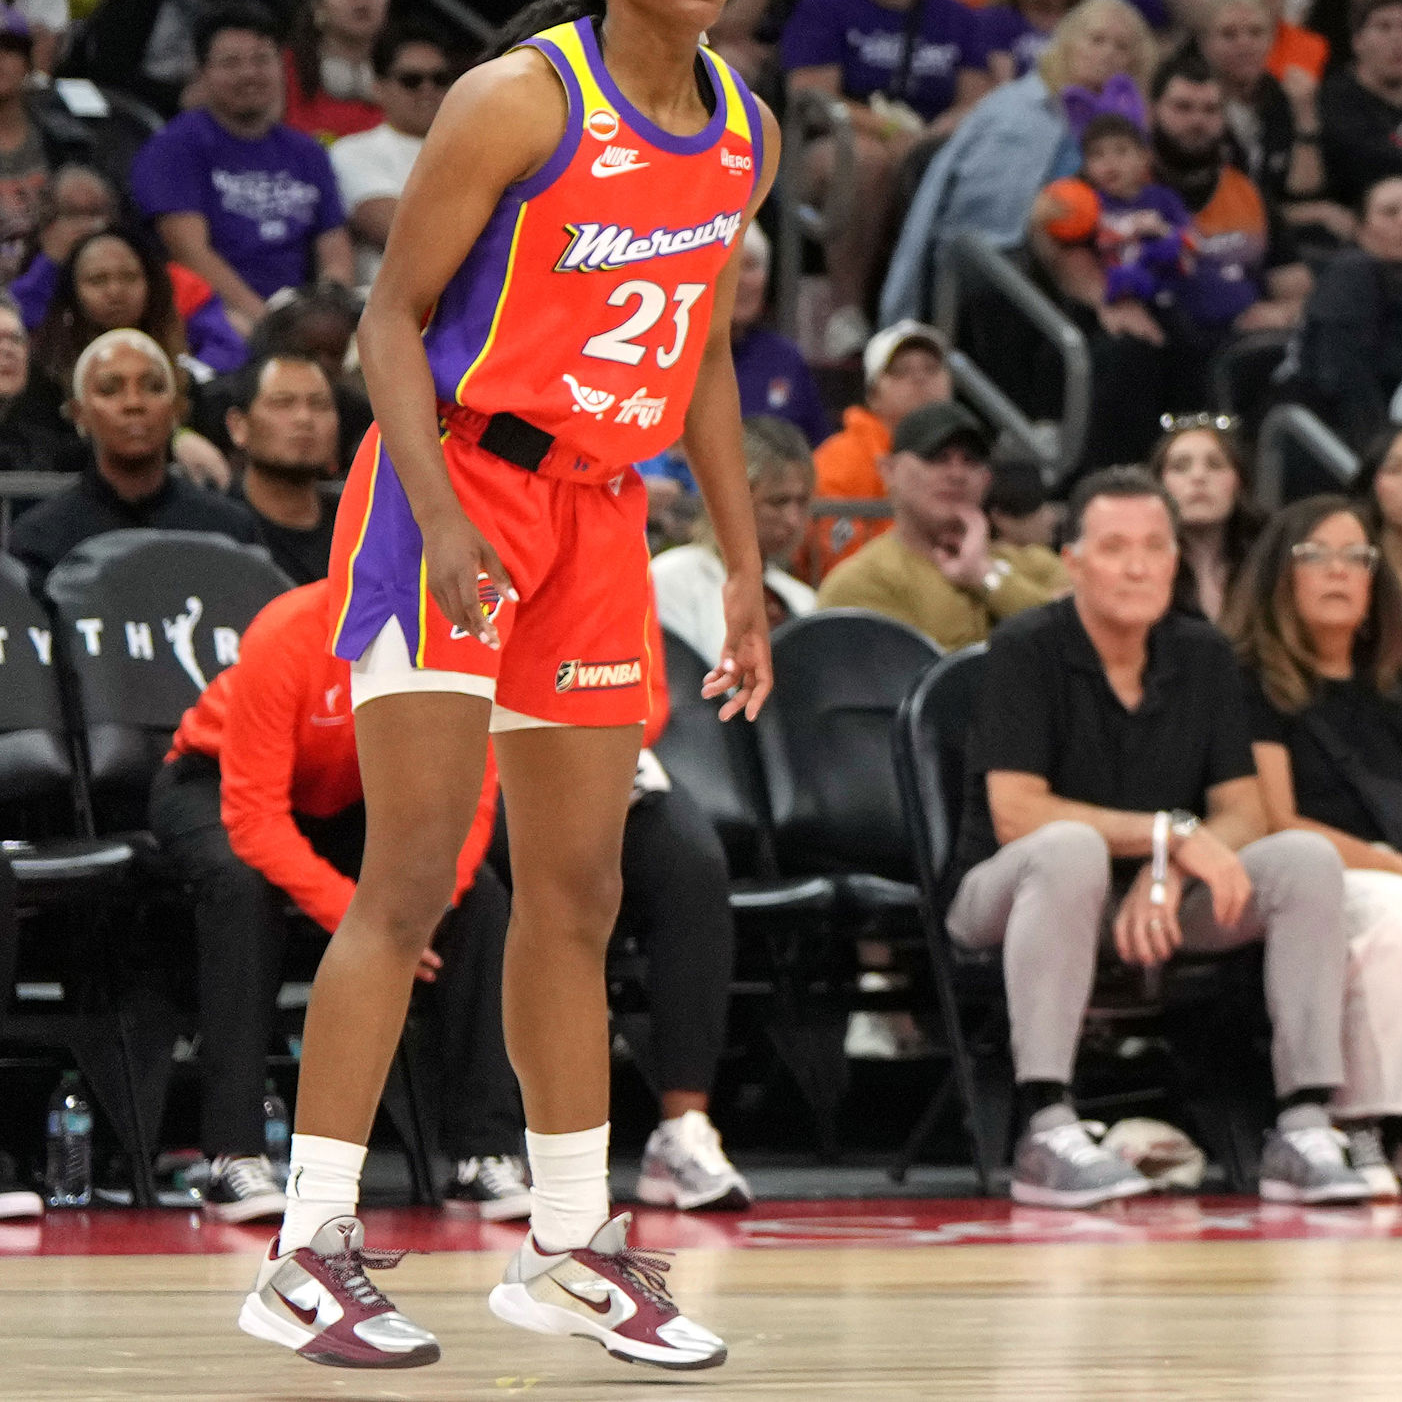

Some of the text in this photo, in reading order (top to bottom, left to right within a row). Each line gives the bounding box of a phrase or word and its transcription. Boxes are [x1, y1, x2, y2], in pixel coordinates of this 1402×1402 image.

[601, 145, 639, 167] NIKE
[720, 146, 751, 171] HERO
[555, 209, 742, 272] Mercury
[581, 278, 708, 370] 23
[578, 661, 641, 687] WNBA
